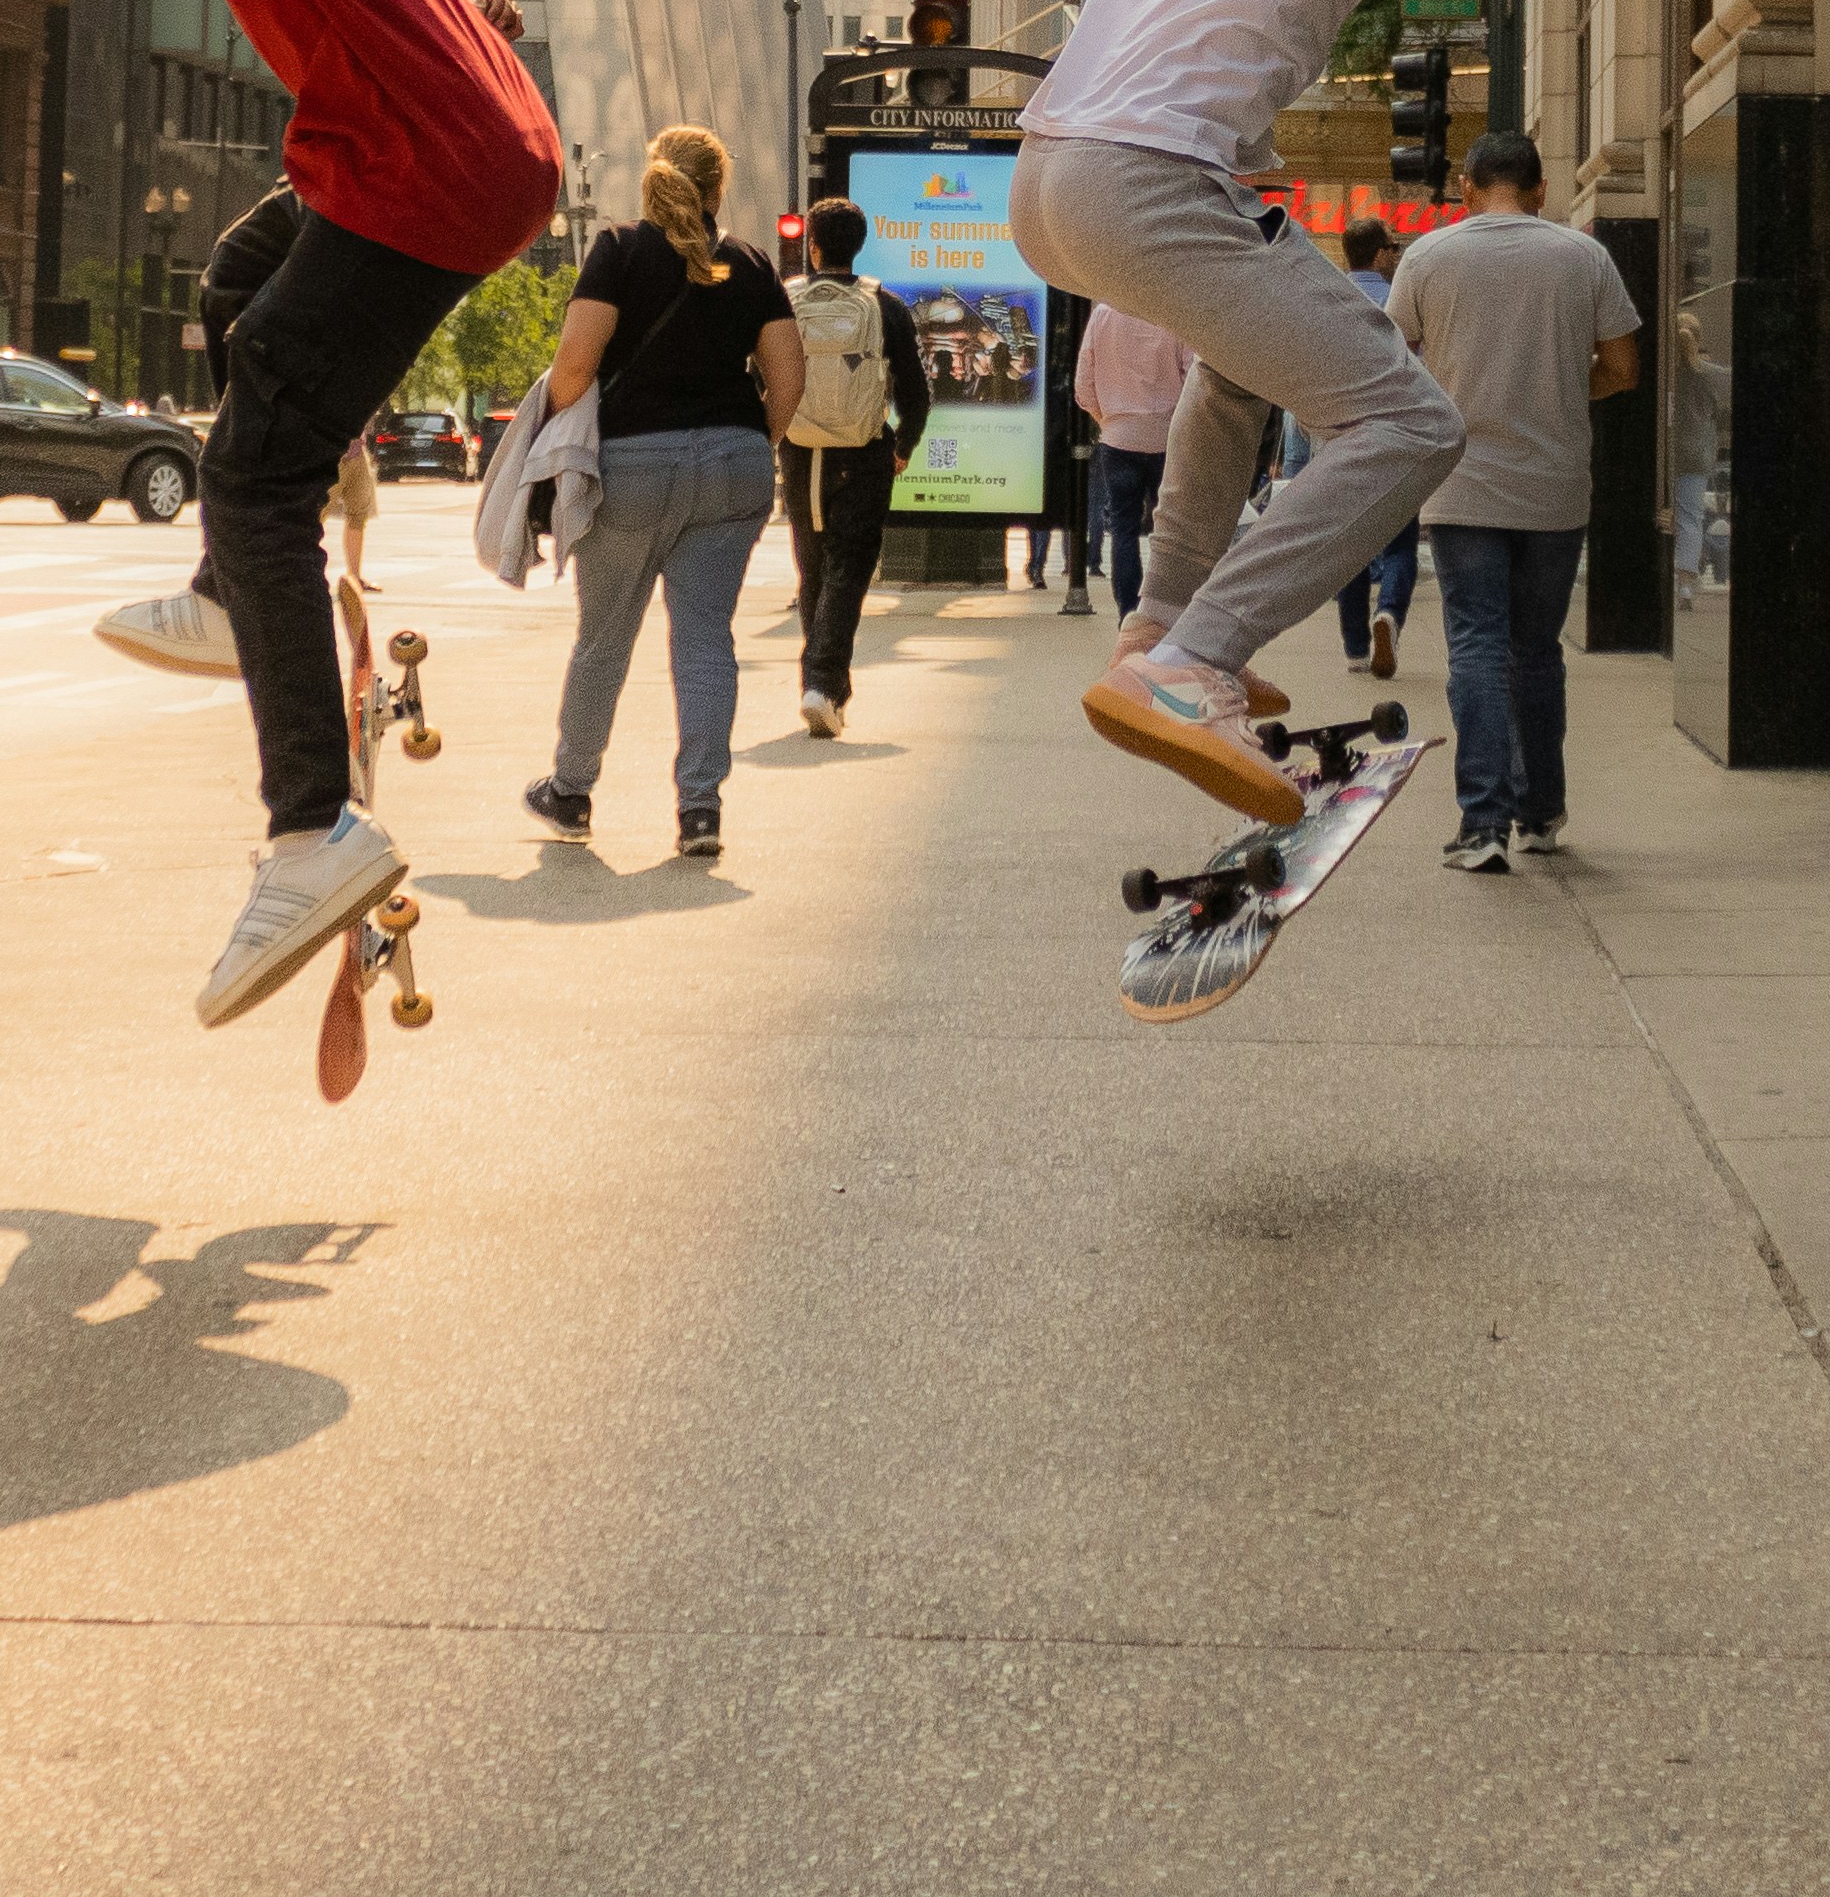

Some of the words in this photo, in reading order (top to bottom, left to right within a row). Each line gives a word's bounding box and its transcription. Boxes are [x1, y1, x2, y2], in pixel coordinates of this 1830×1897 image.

[870, 109, 913, 126] CITY
[915, 109, 1018, 128] INFORMATIO
[874, 216, 922, 239] Your
[929, 221, 1014, 241] summe
[910, 245, 929, 268] is
[936, 245, 984, 269] here
[938, 493, 971, 504] CHICAGO
